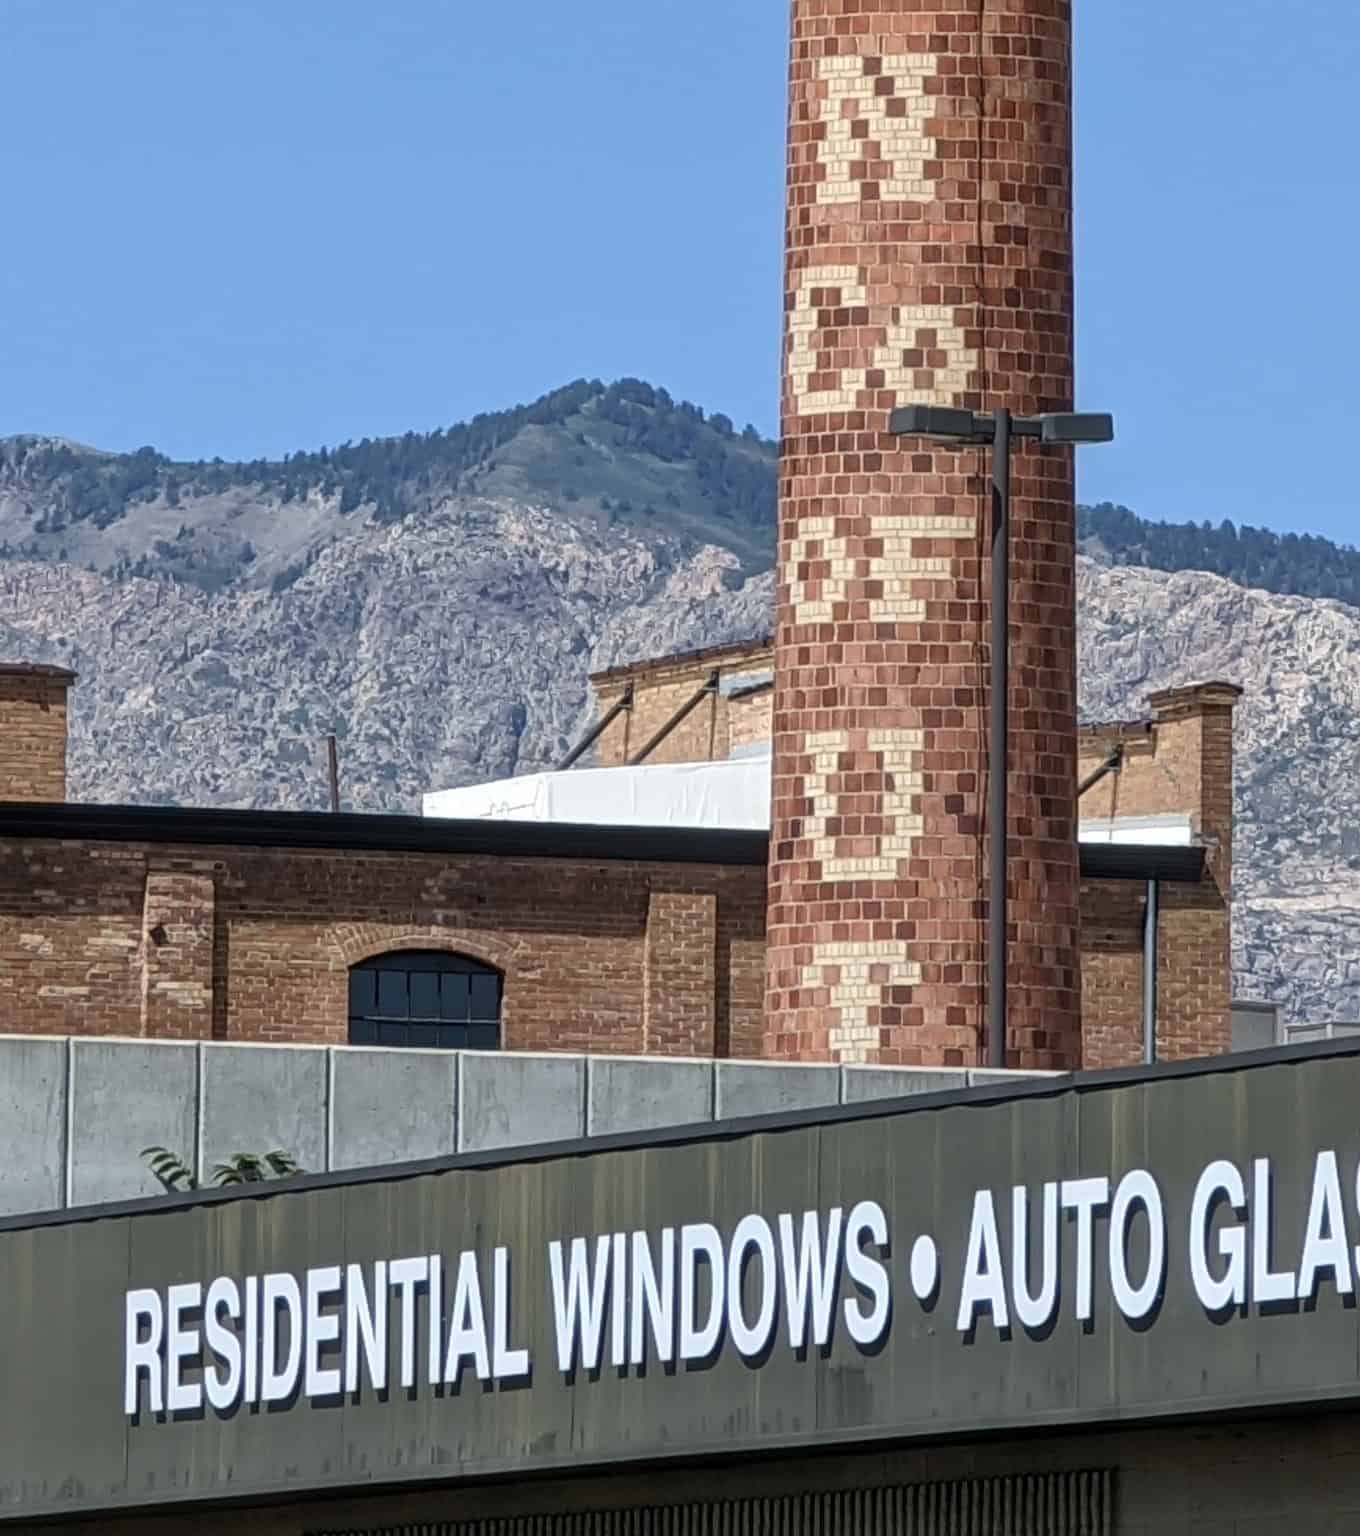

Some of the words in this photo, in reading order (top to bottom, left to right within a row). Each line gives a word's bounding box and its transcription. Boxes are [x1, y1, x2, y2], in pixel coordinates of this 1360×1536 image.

[125, 1246, 529, 1414] RESIDENTIAL
[549, 1200, 890, 1371] WINDOWS
[956, 1169, 1164, 1331] AUTO
